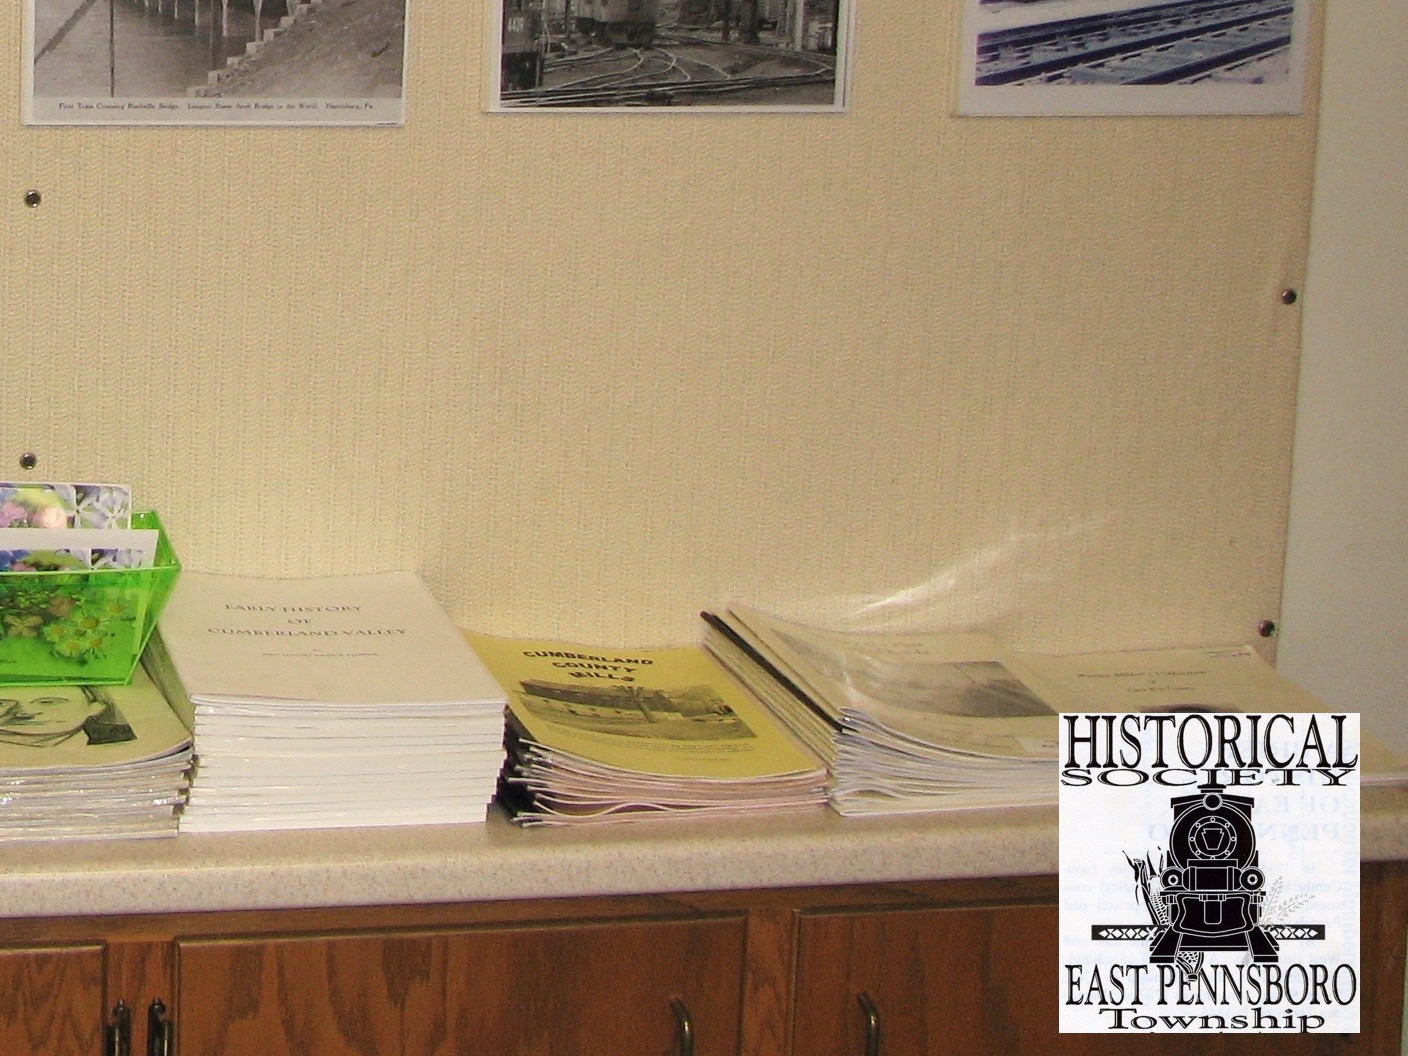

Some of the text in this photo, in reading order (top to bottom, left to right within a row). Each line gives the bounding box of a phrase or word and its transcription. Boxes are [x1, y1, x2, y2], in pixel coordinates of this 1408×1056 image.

[225, 604, 276, 612] EARLY
[208, 628, 338, 636] CUMBERLAND
[522, 651, 654, 665] CUMBERLAND
[551, 661, 638, 673] COUNTY
[568, 671, 636, 682] MILLS
